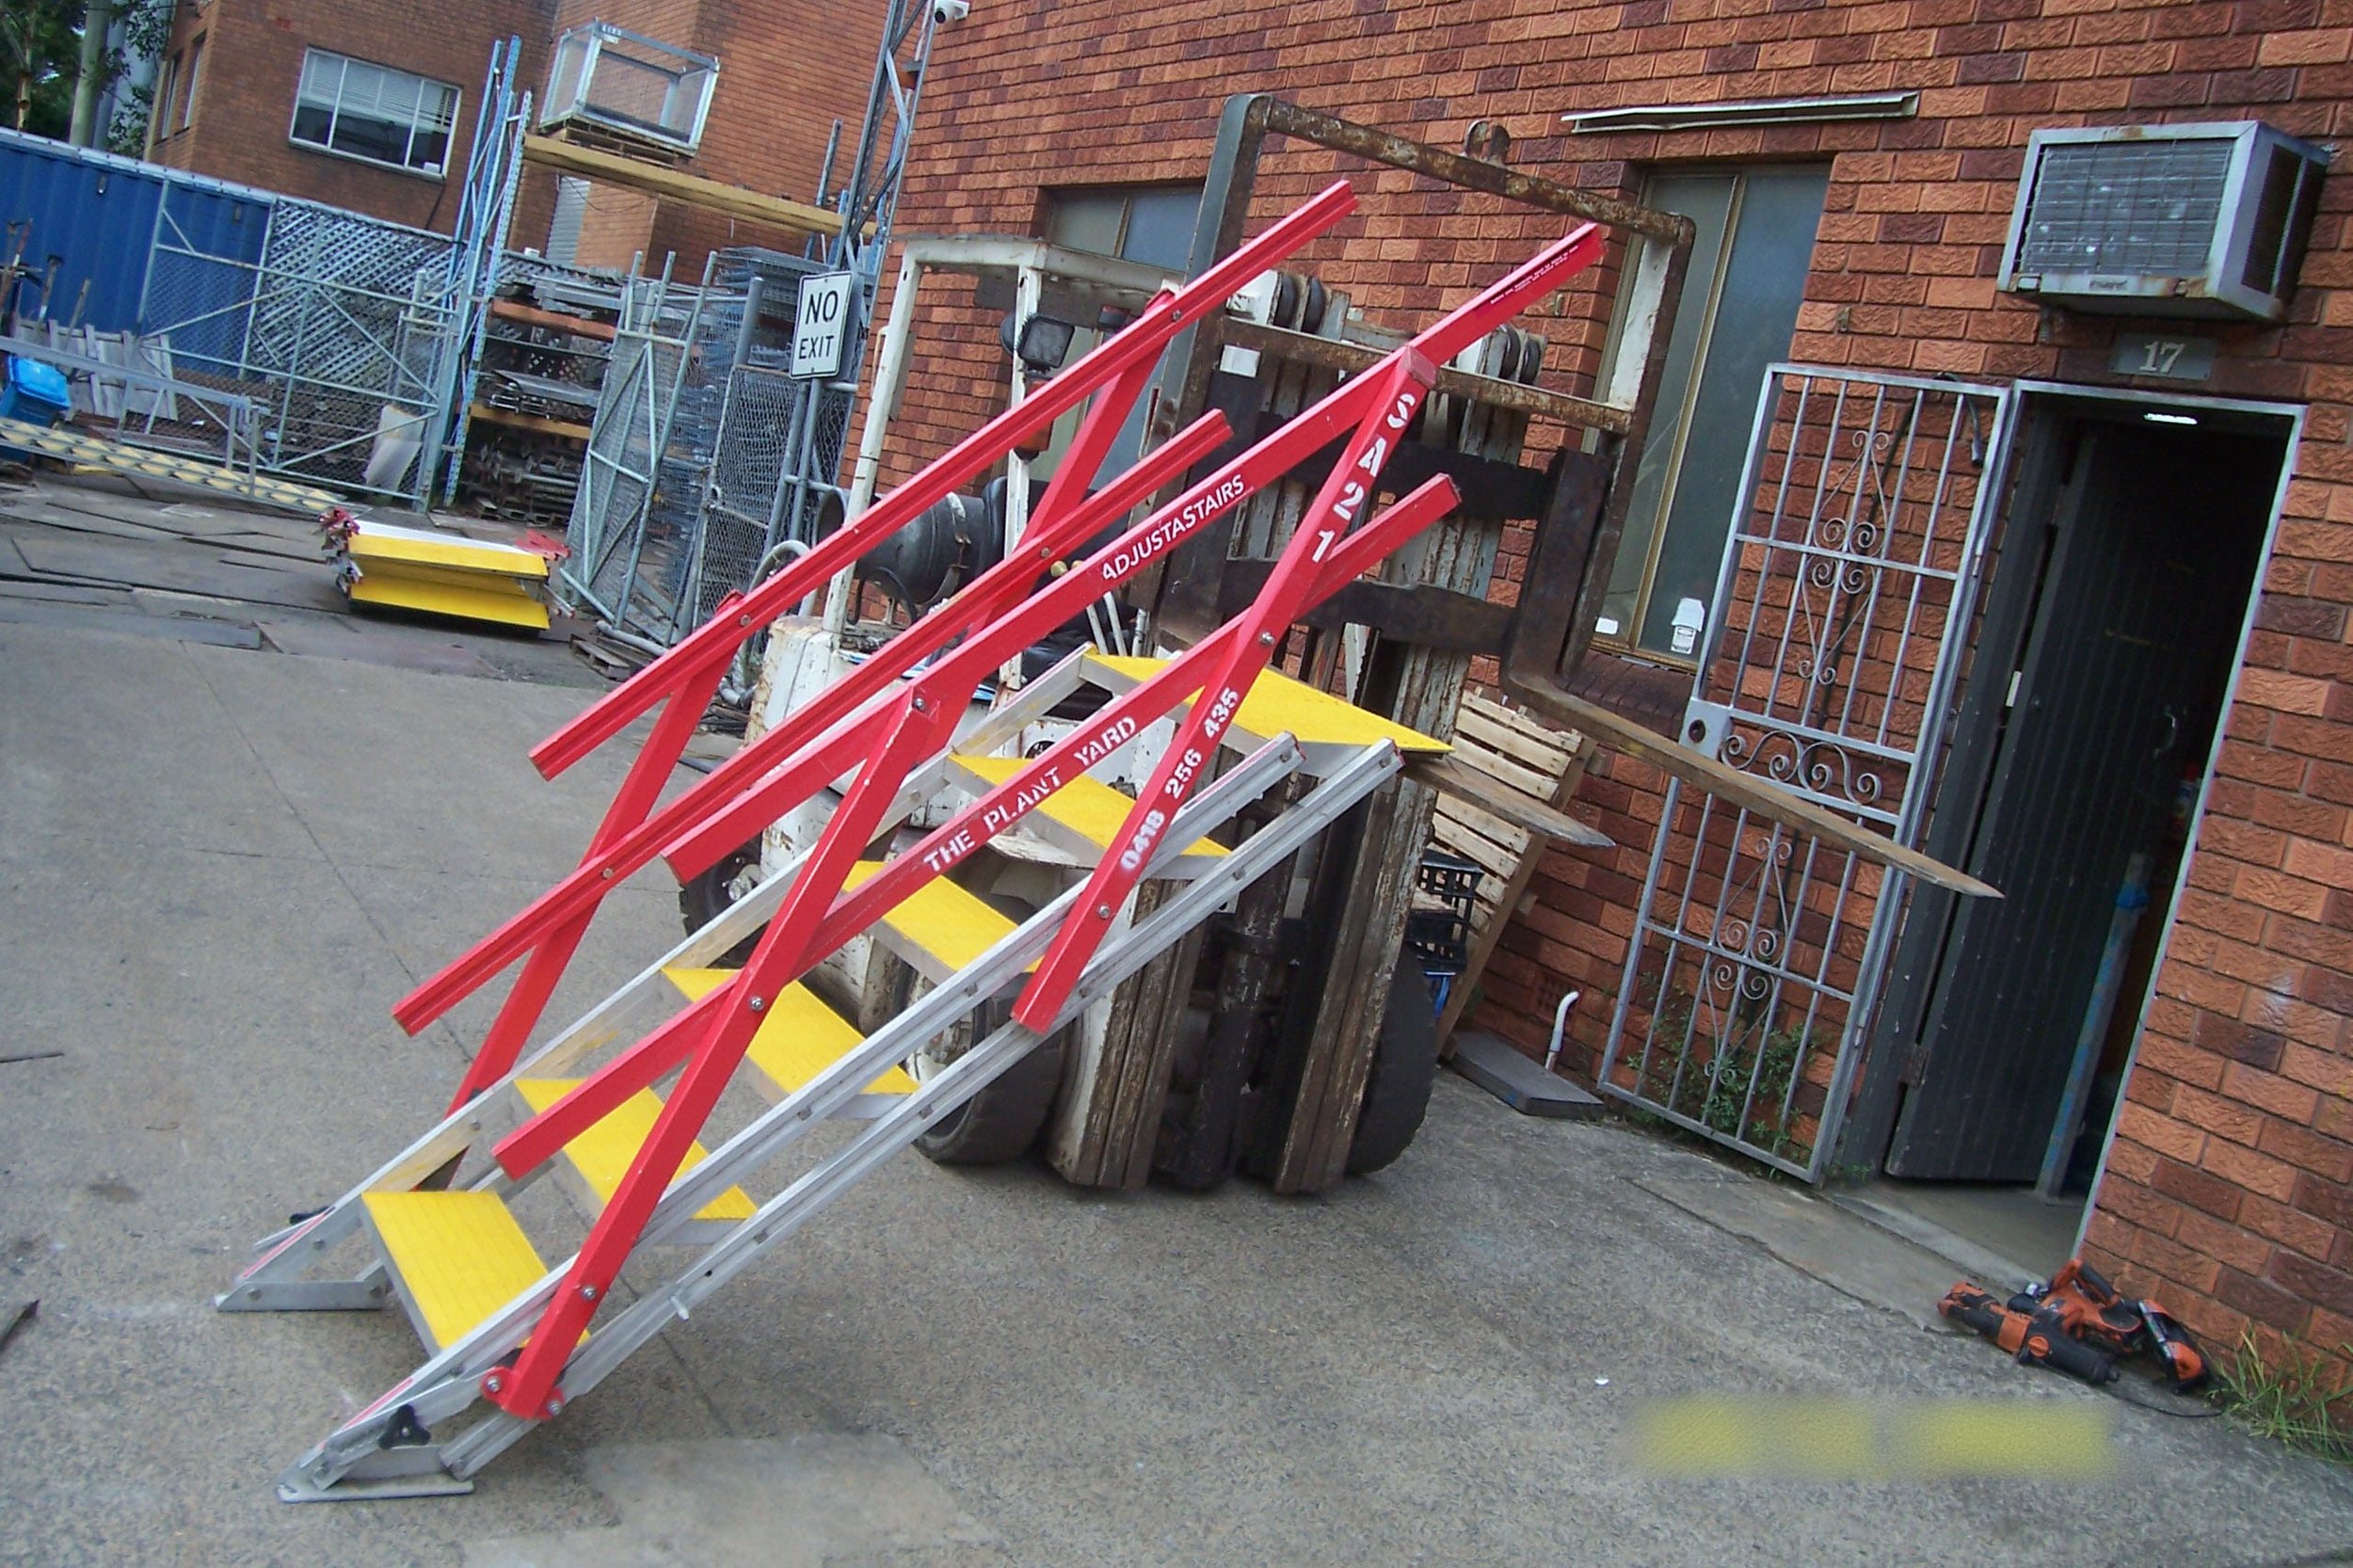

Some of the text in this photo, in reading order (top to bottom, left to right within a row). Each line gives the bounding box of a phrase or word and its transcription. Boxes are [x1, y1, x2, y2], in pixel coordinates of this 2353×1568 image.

[805, 290, 839, 325] NO
[798, 335, 835, 360] EXIT
[2139, 341, 2185, 374] 17
[1101, 473, 1244, 580] ADJUSTASTAIRS
[923, 716, 1136, 872] THE PLANT YARD
[1120, 687, 1239, 871] 0418 256 435
